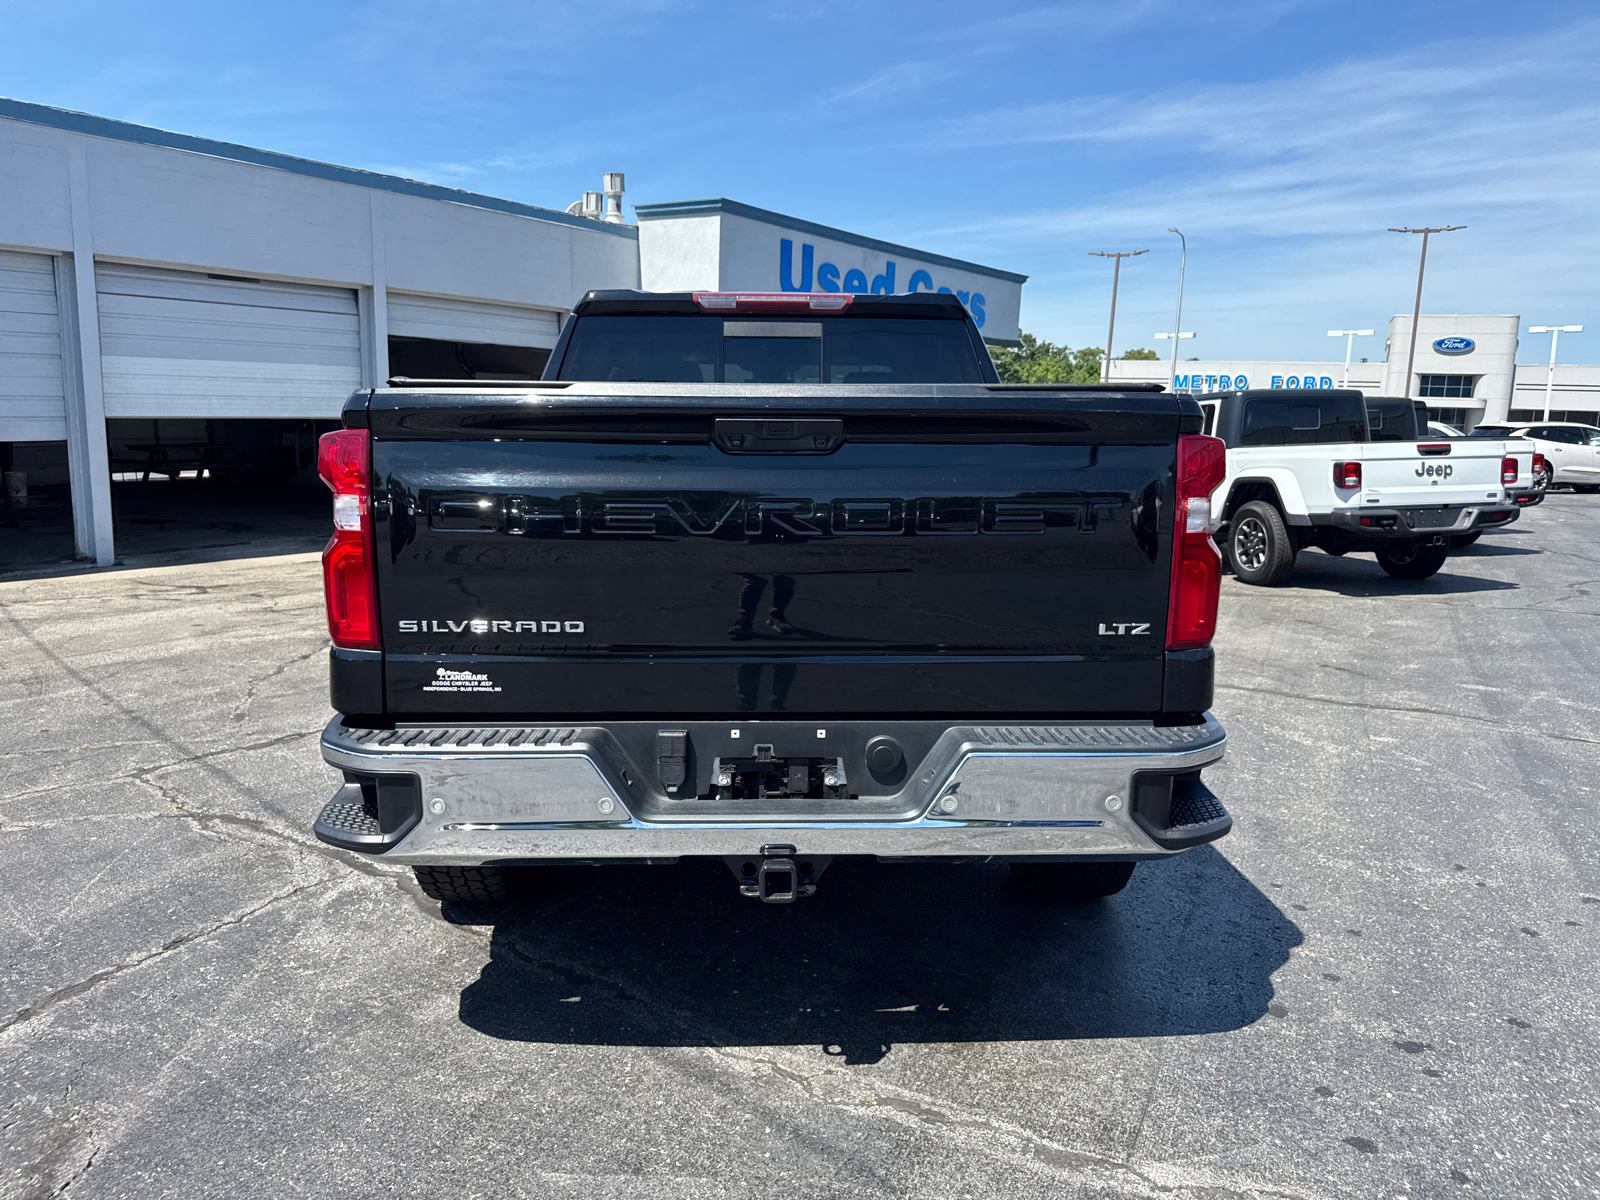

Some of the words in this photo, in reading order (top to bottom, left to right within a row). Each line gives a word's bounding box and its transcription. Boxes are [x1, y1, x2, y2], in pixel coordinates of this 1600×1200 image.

[780, 238, 896, 295] Used
[1441, 338, 1467, 349] Ford
[1173, 374, 1248, 390] METRO
[1271, 375, 1333, 390] FORD
[1414, 461, 1453, 479] Jeep
[427, 496, 1125, 535] CHEVROLET
[398, 619, 585, 634] SILVERADO
[1098, 622, 1151, 635] LTZ
